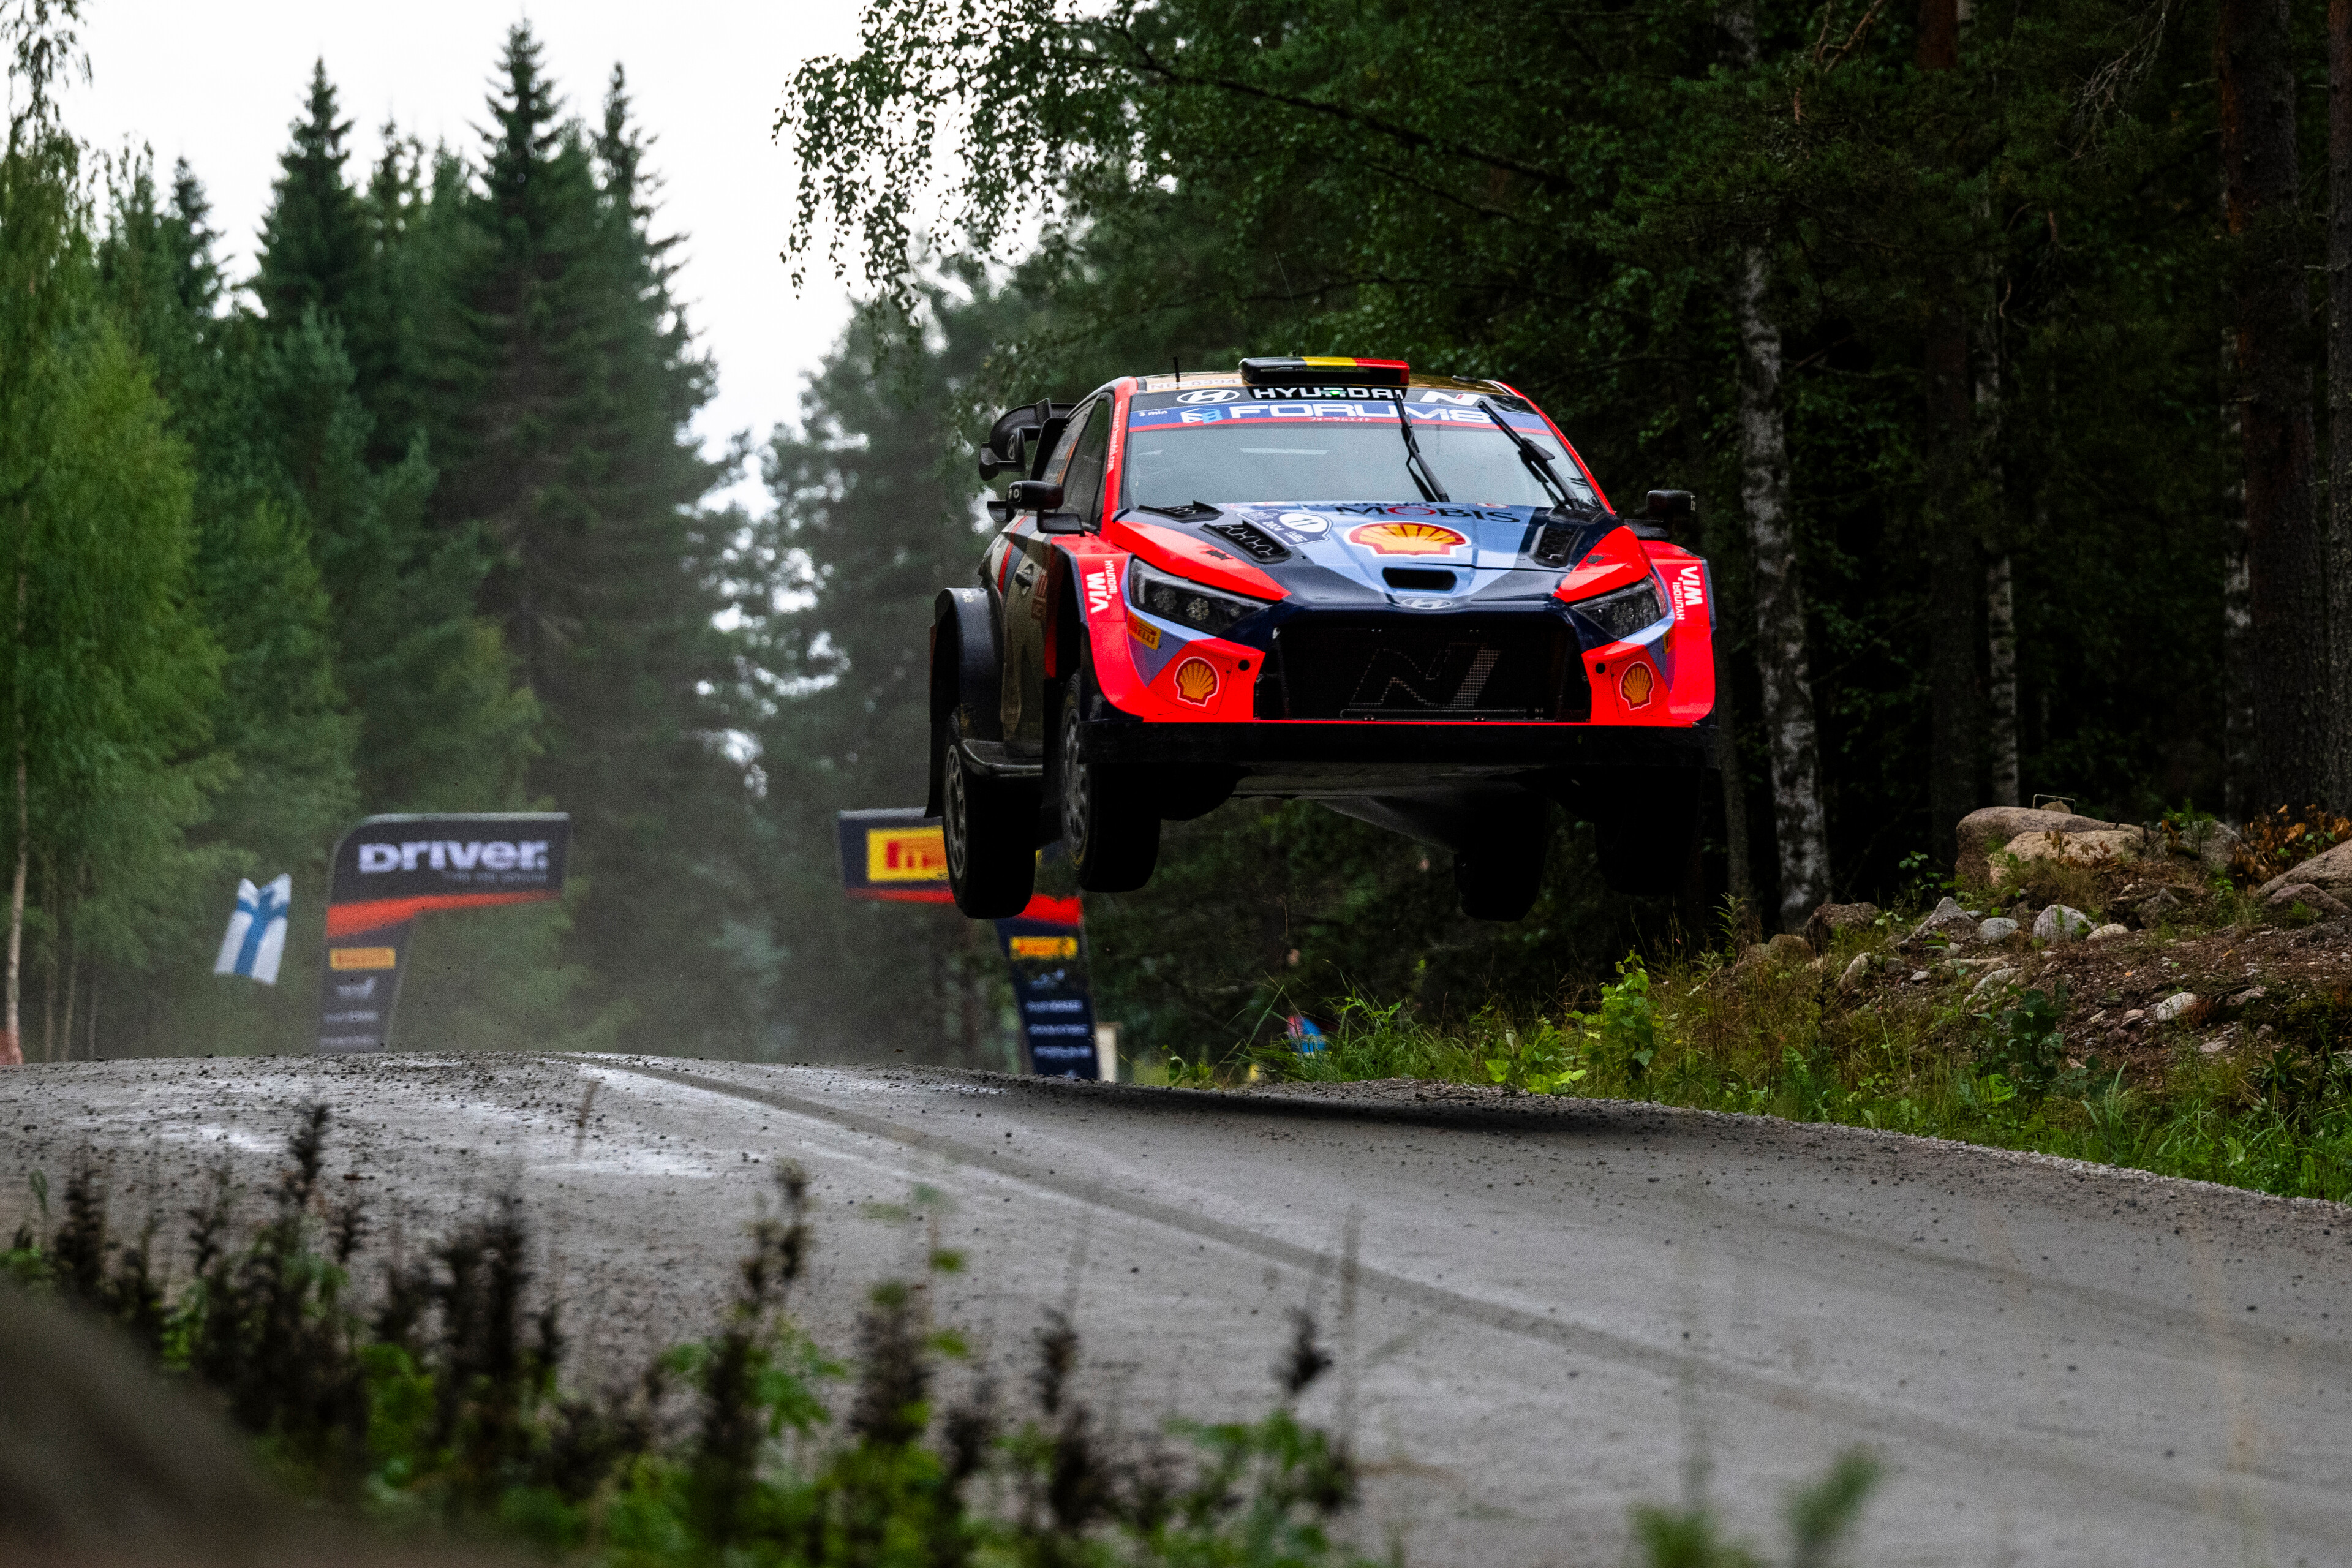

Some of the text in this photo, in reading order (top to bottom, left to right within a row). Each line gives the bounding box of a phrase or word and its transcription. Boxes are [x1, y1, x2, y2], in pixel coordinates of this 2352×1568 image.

[1288, 518, 1319, 527] 11
[1334, 506, 1520, 522] MOBIS
[1104, 560, 1117, 594] HYUNDAI
[1672, 582, 1685, 620] HYUNDAI
